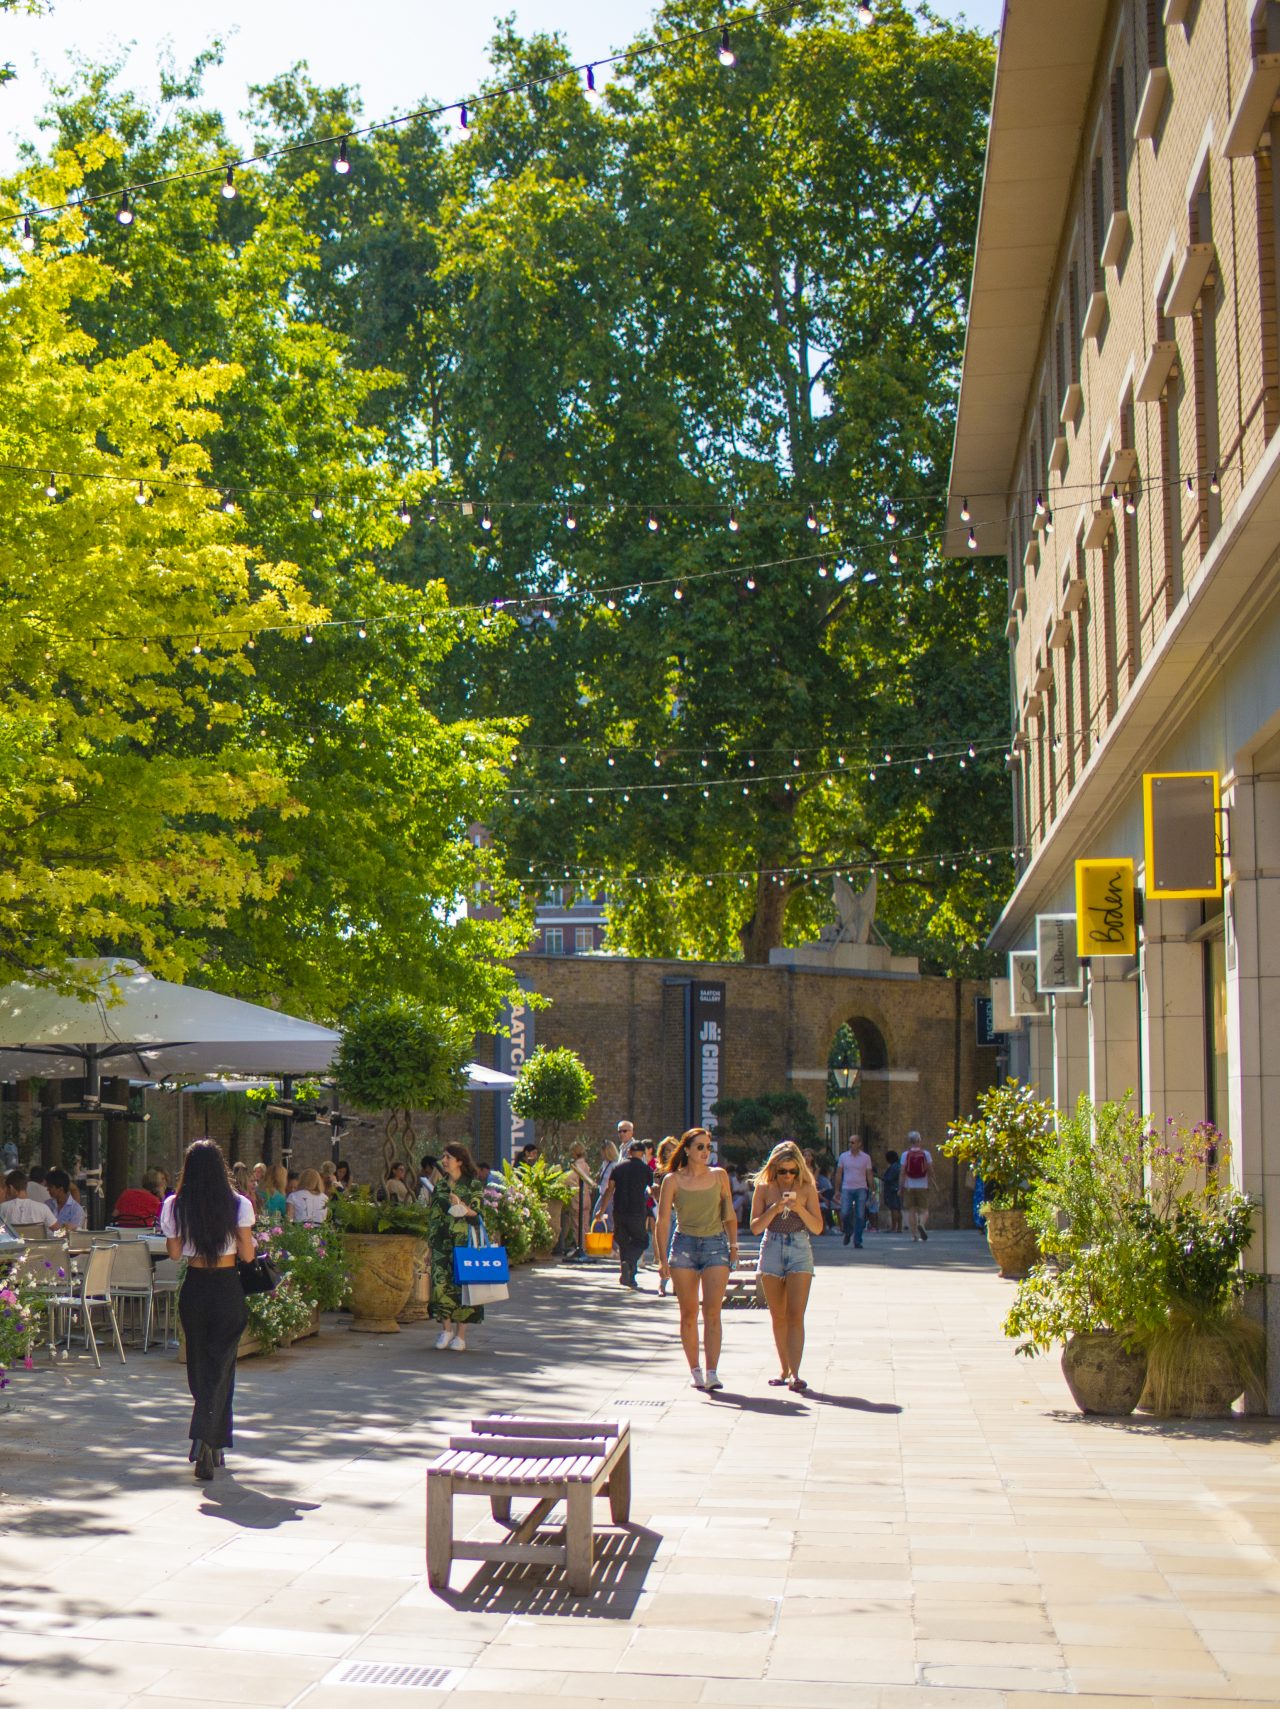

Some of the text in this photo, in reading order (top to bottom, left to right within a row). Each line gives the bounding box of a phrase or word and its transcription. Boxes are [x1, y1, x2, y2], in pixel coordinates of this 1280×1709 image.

[1088, 871, 1125, 943] Boden
[1021, 961, 1037, 1004] COS
[700, 1020, 722, 1041] JR:
